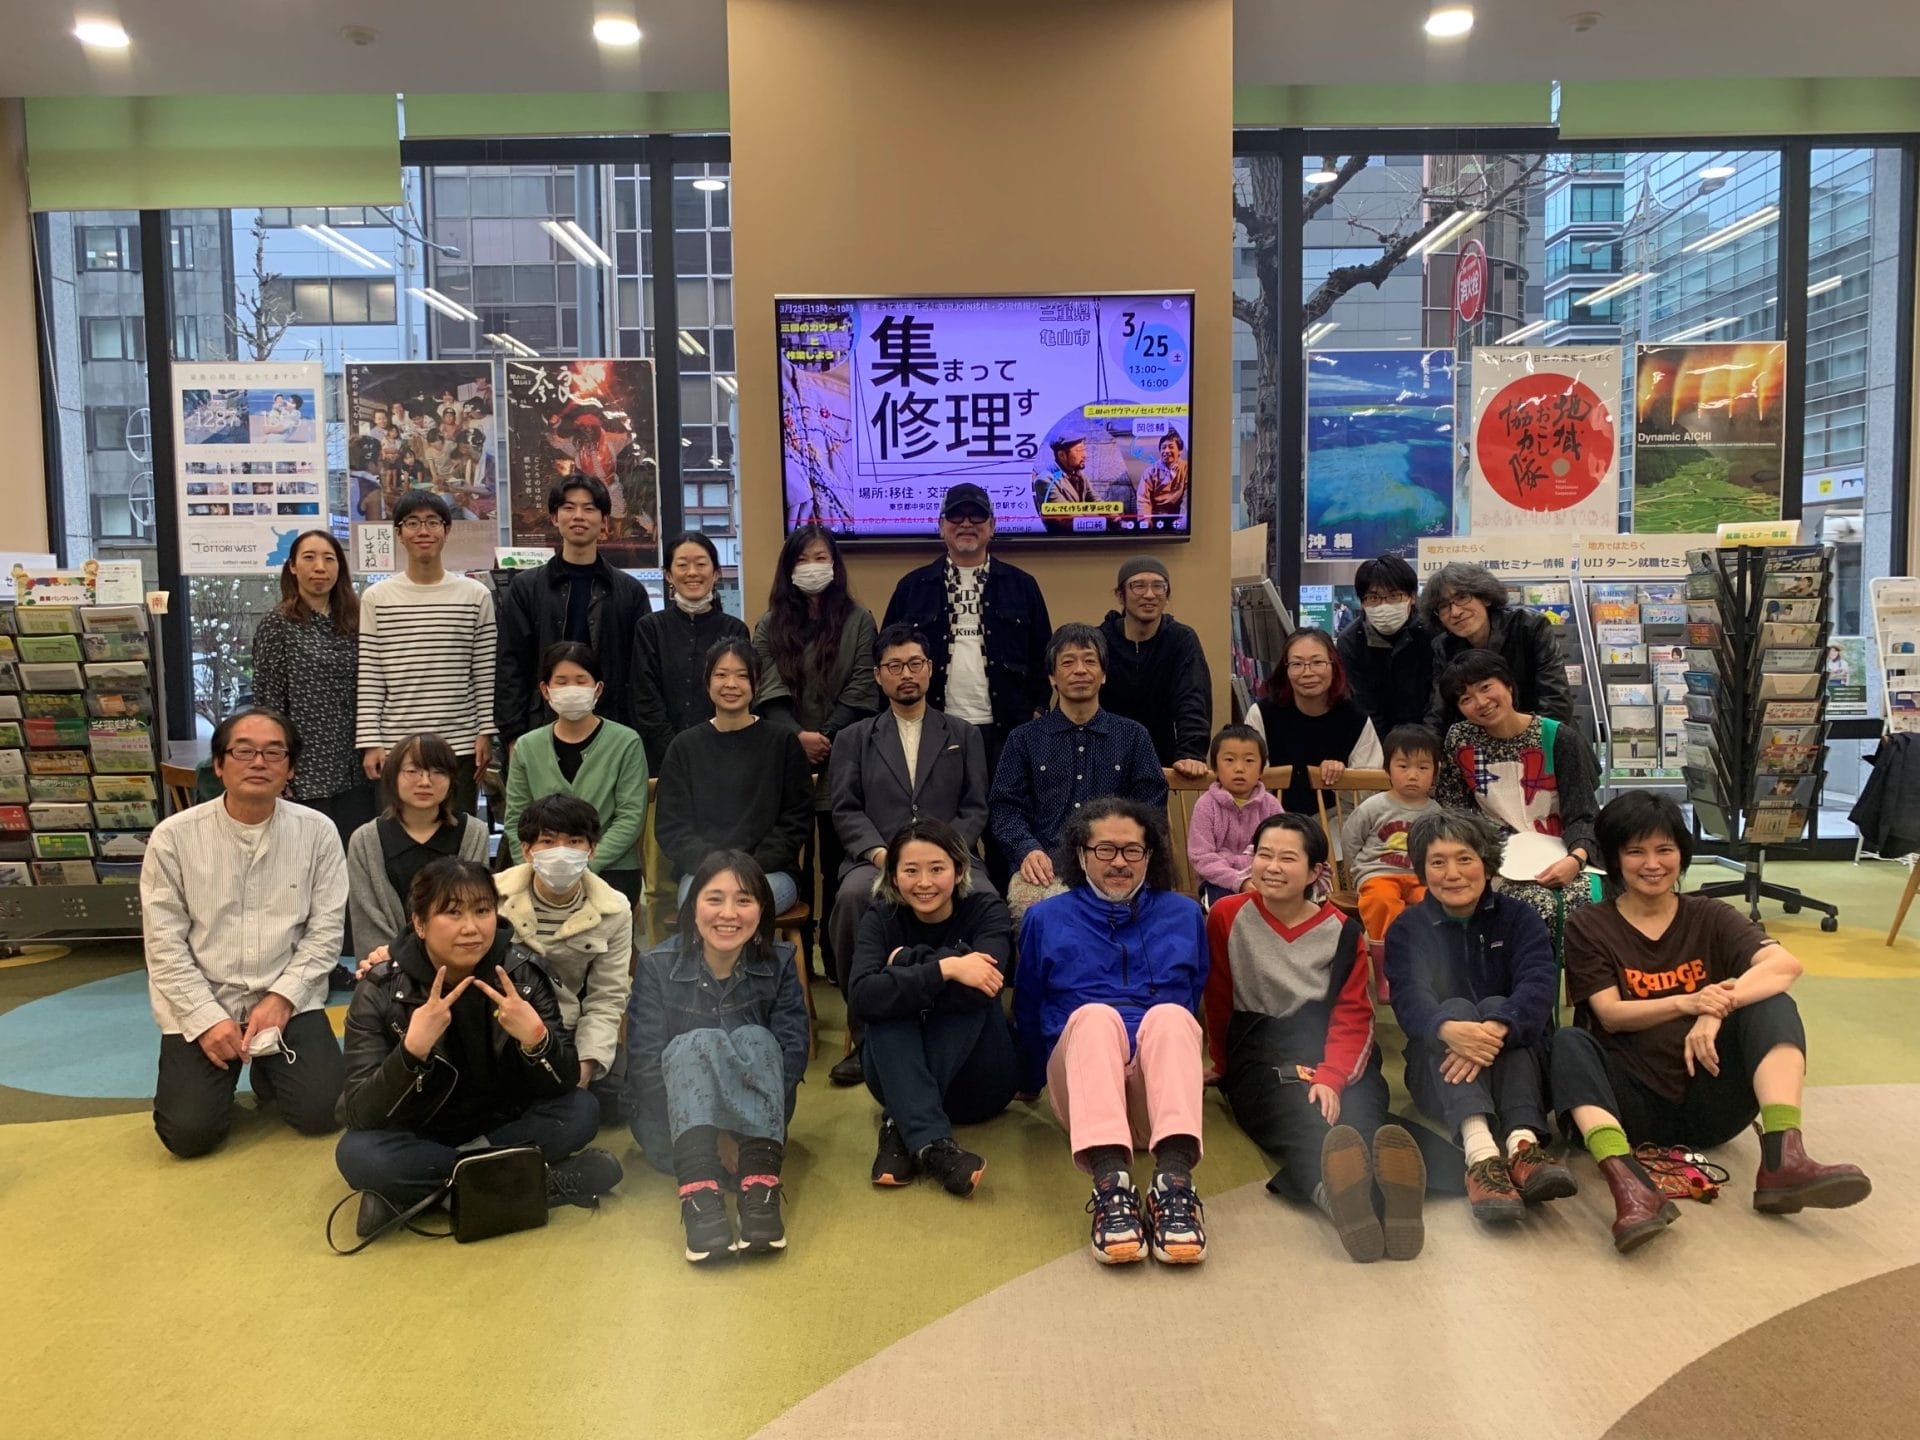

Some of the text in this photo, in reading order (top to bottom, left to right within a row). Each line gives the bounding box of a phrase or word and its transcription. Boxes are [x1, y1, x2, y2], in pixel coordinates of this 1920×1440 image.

[1040, 328, 1090, 346] 亀山市
[870, 315, 1017, 387] 集まって
[1173, 352, 1182, 362] 土
[1141, 379, 1169, 388] 16:00
[871, 389, 1039, 460] 修理する
[1536, 405, 1551, 457] おこし
[1552, 392, 1592, 461] 地域
[1638, 432, 1712, 443] Dynamic AICHI
[233, 544, 257, 553] WEST
[364, 528, 377, 568] しまね
[377, 528, 391, 554] 民泊
[1427, 544, 1486, 554] 地方ではたらく
[1588, 541, 1646, 550] 地方ではたらく
